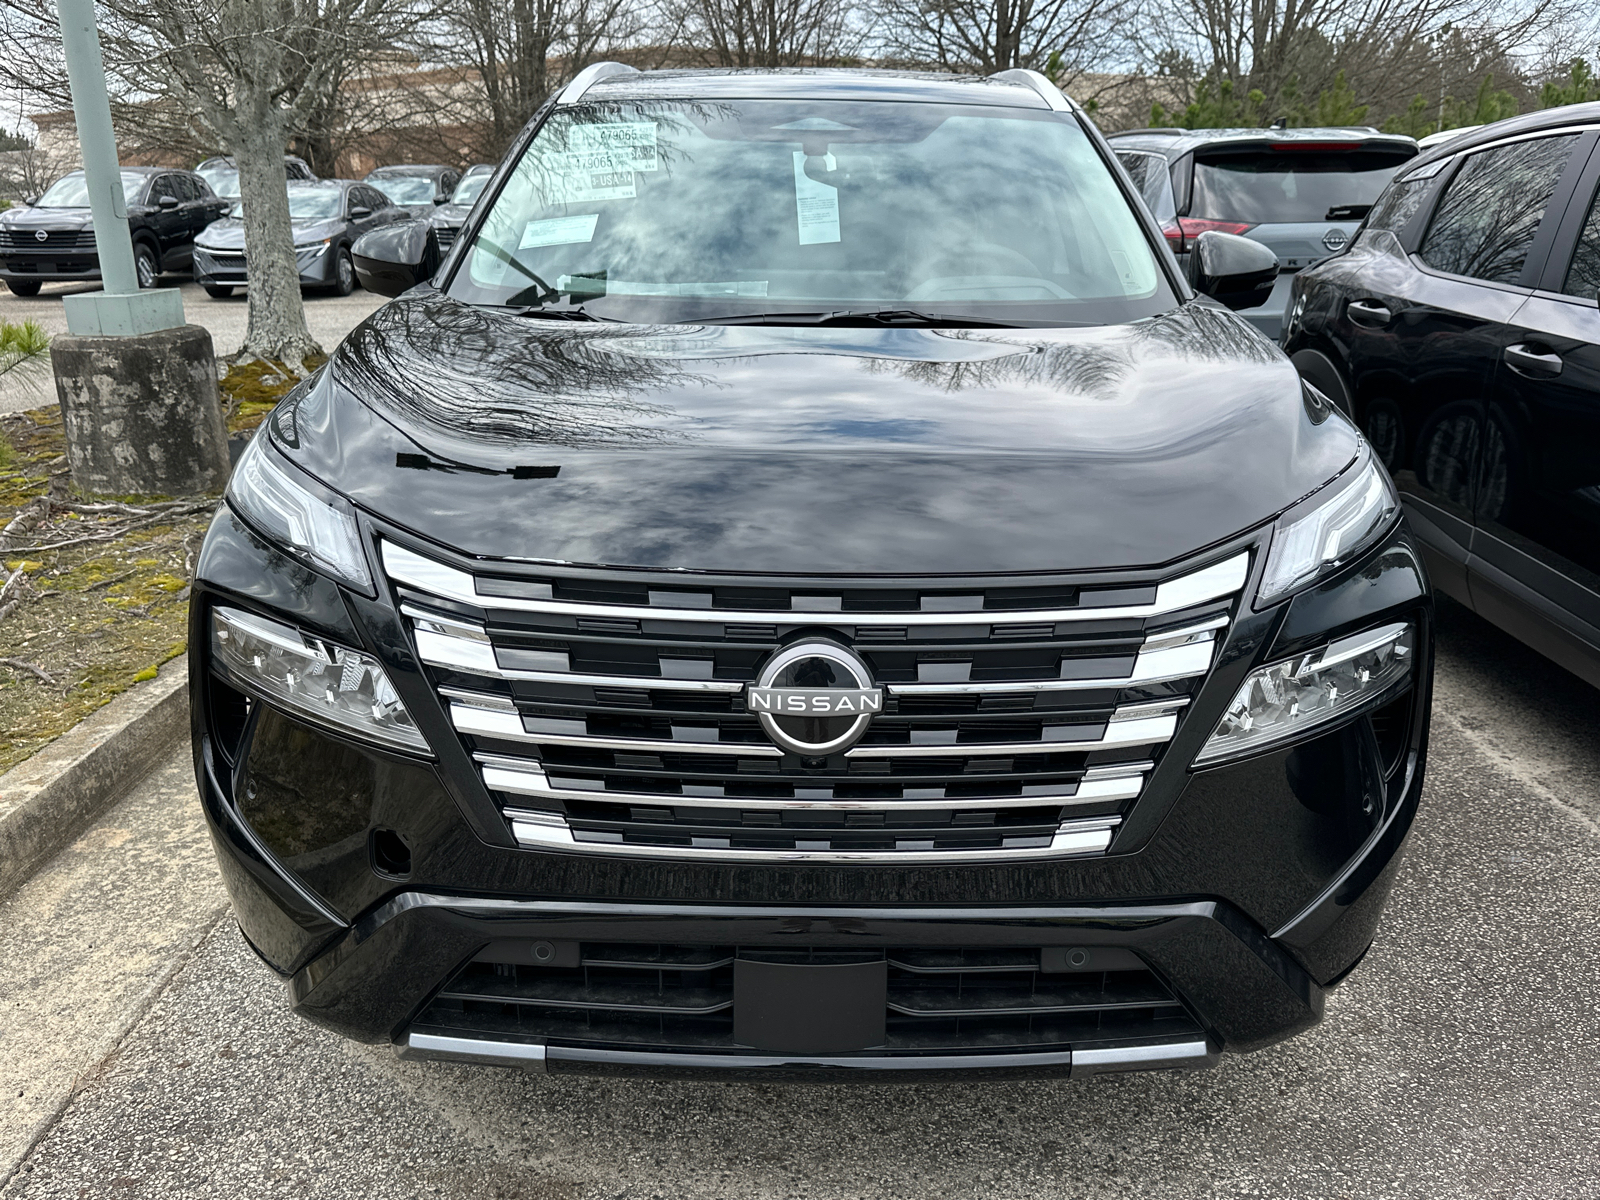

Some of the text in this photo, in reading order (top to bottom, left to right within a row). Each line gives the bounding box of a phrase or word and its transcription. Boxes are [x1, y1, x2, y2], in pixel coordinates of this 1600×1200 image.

[600, 129, 637, 141] 479065
[574, 156, 613, 170] 479065
[600, 173, 620, 186] USA
[752, 692, 879, 712] NISSAN
